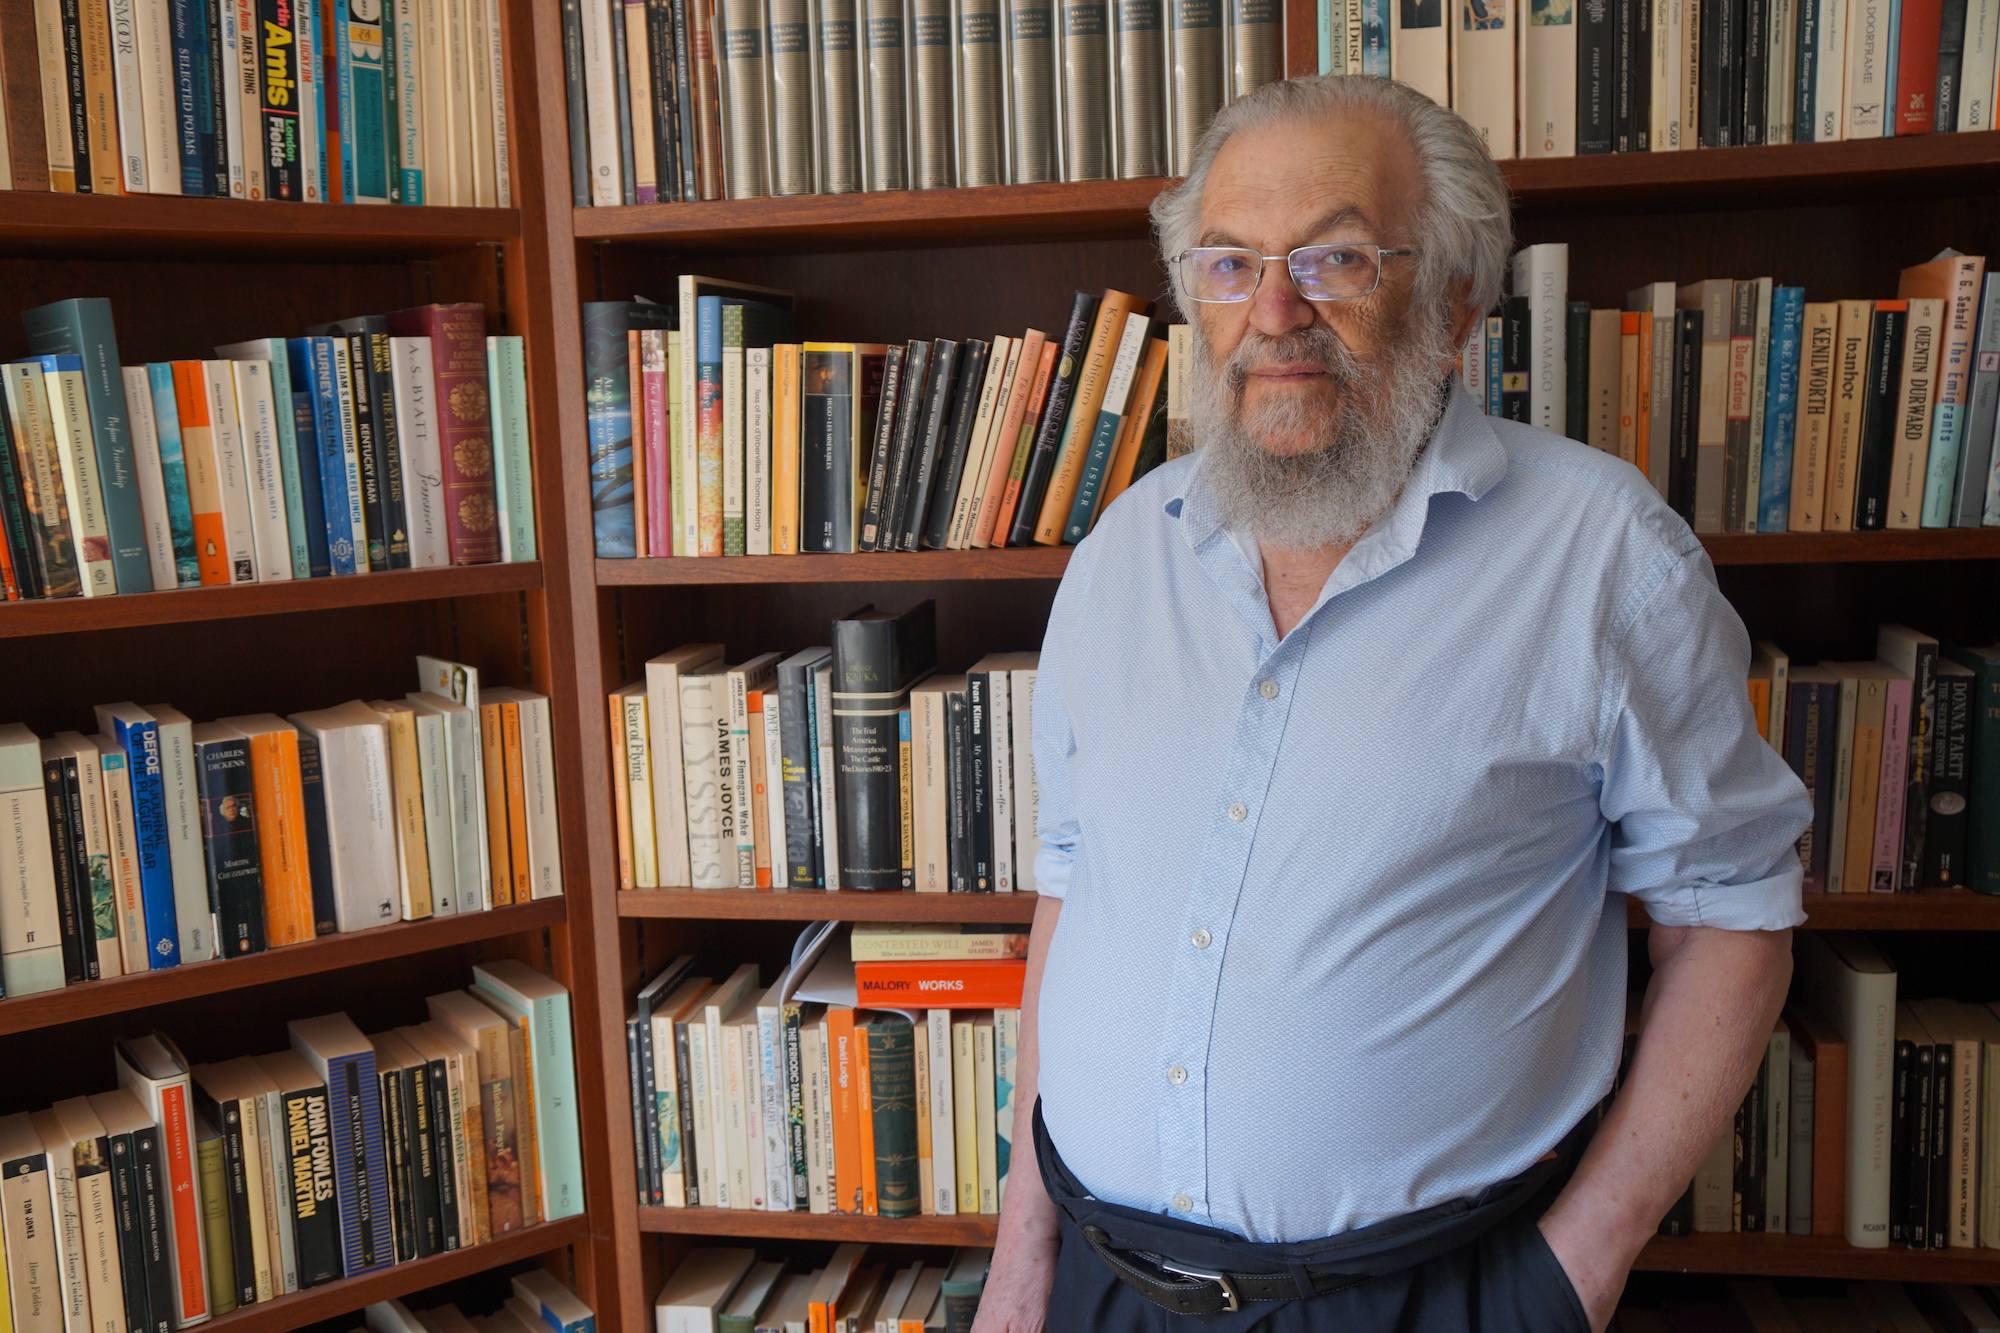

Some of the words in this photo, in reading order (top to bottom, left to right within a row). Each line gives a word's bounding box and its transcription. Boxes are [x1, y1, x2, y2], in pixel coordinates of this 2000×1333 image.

[68, 24, 78, 54] TWILIGHT
[241, 35, 254, 64] JAKE'S
[301, 39, 311, 65] LUCKY
[401, 22, 414, 79] Collected
[1863, 6, 1876, 84] DOORFRAME
[70, 54, 78, 64] OF
[264, 19, 294, 106] Amis
[178, 48, 193, 112] SELECTED
[244, 68, 256, 94] THING
[302, 67, 312, 83] JIM
[340, 77, 348, 96] LAST
[75, 103, 83, 116] THE
[403, 80, 415, 125] Shorter
[1592, 81, 1600, 125] PULLMAN
[1969, 100, 1981, 126] PICADOR
[183, 114, 196, 156] POEMS
[342, 98, 350, 144] GOODNIGHT
[1824, 111, 1834, 137] PICADOR
[269, 116, 286, 167] Fields
[285, 119, 296, 162] London
[405, 127, 417, 166] Poems
[407, 171, 417, 202] FABER
[1961, 262, 1975, 275] W.
[1542, 271, 1555, 301] JOSÉ
[1959, 280, 1973, 290] G.
[702, 305, 712, 322] Ted
[1096, 306, 1117, 348] Kazuo
[1783, 301, 1796, 332] THE
[1954, 296, 1970, 330] Sebald
[409, 344, 420, 359] A.
[699, 324, 711, 360] Hughes
[1491, 340, 1499, 354] FOR
[1541, 307, 1553, 392] SARAMAGO
[1911, 325, 1932, 373] QUENTIN
[1950, 340, 1968, 363] The
[316, 342, 332, 397] BURNEY
[337, 350, 347, 388] WILLIAM
[1080, 352, 1108, 405] Ishiguro
[1470, 343, 1479, 387] BLOOD
[1778, 340, 1793, 403] READER
[1807, 327, 1831, 415] KENILWORTH
[1841, 337, 1862, 400] Ivanhoe
[594, 377, 604, 399] THE
[604, 377, 614, 402] ALAN
[700, 366, 712, 405] Birthday
[754, 388, 762, 403] Tess
[886, 364, 898, 397] BRAVE
[1491, 382, 1499, 402] WITH
[65, 379, 78, 423] BRADDON
[259, 400, 269, 413] THE
[412, 385, 427, 441] BYATT
[595, 402, 605, 424] LINE
[754, 405, 762, 413] of
[883, 400, 893, 420] NEW
[1904, 378, 1928, 440] DURWARD
[1940, 372, 1964, 442] Emigrants
[260, 414, 272, 451] MASTER
[323, 401, 338, 457] EVELINA
[341, 400, 355, 453] BURROUGHS
[597, 428, 605, 442] OF
[702, 408, 712, 440] Letters
[754, 414, 762, 426] the
[1069, 417, 1085, 446] Never
[254, 430, 263, 458] Mikhail
[360, 423, 376, 476] KENTUCKY
[605, 406, 616, 479] HOLLINGHURST
[754, 428, 762, 474] d'Urbervilles
[878, 424, 891, 457] WORLD
[1095, 421, 1112, 459] ALAN
[110, 445, 127, 489] Friendship
[264, 453, 274, 469] AND
[598, 444, 608, 479] BEAUTY
[1064, 449, 1076, 465] Let
[73, 428, 85, 453] LADY
[82, 496, 95, 531] SECRET
[256, 459, 266, 490] Bulgakov
[347, 462, 359, 495] NAKED
[873, 463, 883, 487] ALDOUS
[1060, 467, 1071, 483] Me
[1080, 466, 1098, 507] ISLER
[265, 470, 278, 520] MARGARITA
[366, 479, 377, 503] HAM
[412, 459, 441, 538] Possession
[754, 477, 762, 506] Thomas
[869, 489, 881, 514] HUXLEY
[958, 497, 968, 510] Eyre
[1055, 485, 1066, 501] Go
[351, 498, 362, 523] LUNCH
[753, 508, 762, 532] Hardy
[953, 512, 965, 541] Methuen
[972, 681, 981, 703] Ivan
[1950, 681, 1968, 731] DONNA
[628, 702, 642, 728] Fear
[973, 705, 982, 734] Klíma
[131, 733, 143, 750] OF
[172, 737, 181, 758] HENRY
[629, 730, 642, 741] of
[717, 718, 730, 777] JAMES
[842, 746, 887, 754] Metamorphosis
[973, 744, 982, 757] My
[133, 752, 145, 779] THE
[143, 730, 160, 775] DEFOE
[206, 748, 244, 761] CHARLES
[207, 759, 245, 771] DICKENS
[629, 744, 645, 781] Flying
[851, 755, 861, 763] The
[861, 755, 881, 763] Castle
[1948, 734, 1965, 778] TARTT
[149, 778, 159, 787] A
[174, 759, 183, 781] JAMES
[682, 682, 722, 880] ULYSSES
[735, 760, 747, 807] Finnegans
[974, 759, 982, 785] Golden
[135, 781, 151, 833] PLAGUE
[721, 783, 734, 839] JOYCE
[975, 787, 983, 813] Trades
[150, 788, 166, 848] JOURNAL
[739, 810, 749, 836] Wake
[122, 858, 132, 876] MOLL
[142, 835, 156, 869] YEAR
[739, 852, 751, 884] FABER
[124, 877, 135, 910] FLANDERS
[863, 981, 911, 991] MALORY
[917, 980, 964, 990] WORKS
[787, 1027, 797, 1044] THE
[838, 1036, 848, 1060] David
[788, 1045, 798, 1082] PERIODIC
[839, 1061, 849, 1088] Lodge
[450, 1087, 461, 1109] THE
[492, 1082, 506, 1122] Michael
[790, 1084, 800, 1107] TABLE
[287, 1097, 310, 1155] DANIEL
[306, 1096, 327, 1135] JOHN
[452, 1112, 463, 1131] TIN
[453, 1133, 465, 1163] MEN
[309, 1137, 333, 1201] FOWLES
[91, 1178, 103, 1225] FLAUBERT
[176, 1181, 189, 1193] 46
[292, 1157, 316, 1218] MARTIN
[1960, 1178, 1968, 1199] MARK
[23, 1199, 32, 1215] TOM
[1960, 1202, 1968, 1226] TWAIN
[26, 1217, 35, 1239] JONES
[29, 1262, 39, 1285] Henry
[31, 1286, 41, 1317] Fielding
